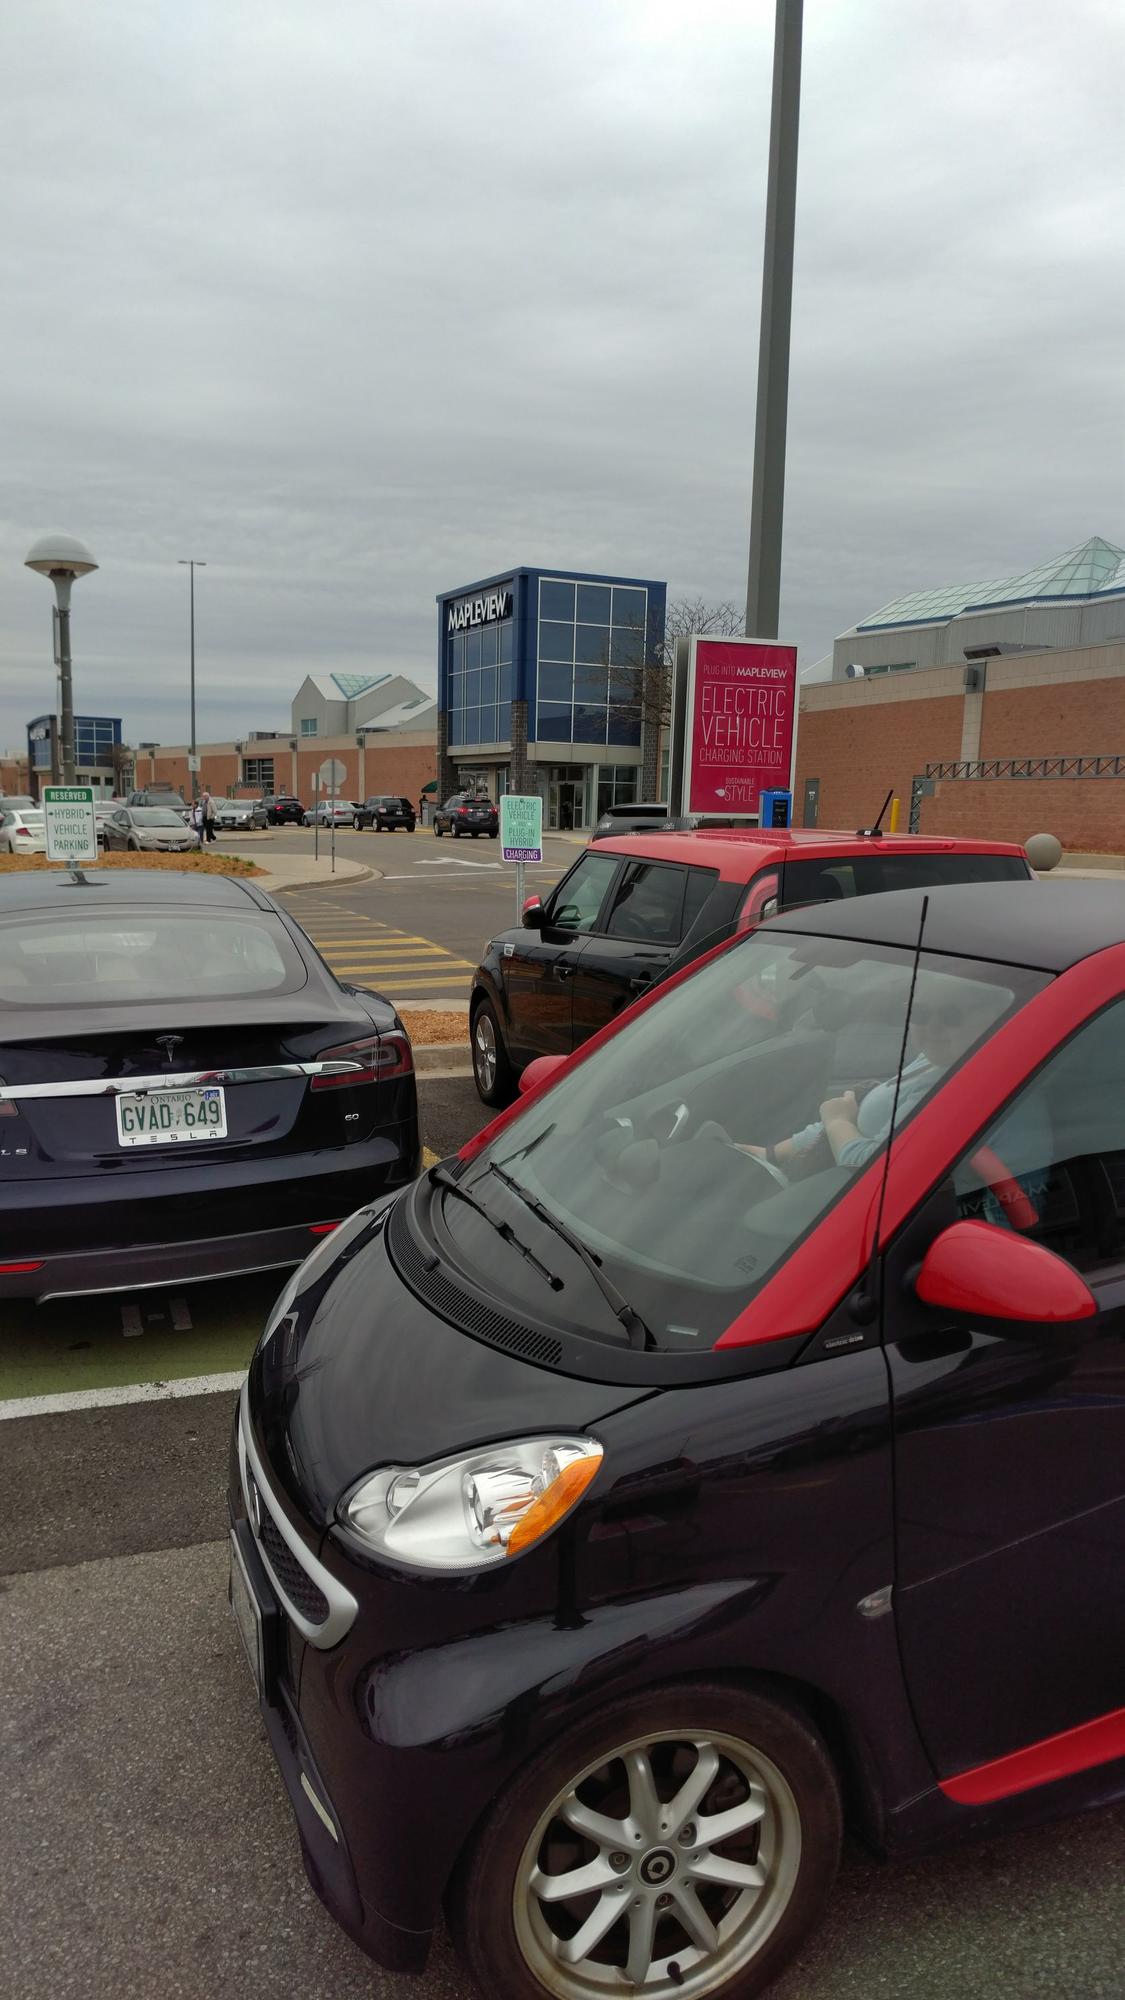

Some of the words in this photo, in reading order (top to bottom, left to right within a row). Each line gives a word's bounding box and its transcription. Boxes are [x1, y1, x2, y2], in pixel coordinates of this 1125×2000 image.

[448, 591, 507, 631] MAPLEVIEW
[704, 664, 719, 675] PLUG
[721, 665, 736, 676] INTO
[736, 667, 787, 679] MAPLEVIEW
[702, 686, 785, 716] ELECTRIC
[701, 715, 784, 748] VEHICLE
[700, 747, 744, 763] CHARGING
[747, 750, 782, 764] STATION
[50, 791, 87, 800] RESERVED
[724, 785, 754, 802] STYLE
[507, 801, 536, 811] ELECTRIC
[55, 808, 85, 819] HYBRID
[508, 811, 534, 820] VEHICLE
[54, 823, 88, 835] VEHICLE
[508, 827, 535, 837] PLUG-IN
[53, 839, 89, 850] PARKING
[510, 838, 534, 847] HYBRID
[506, 849, 538, 859] CHARGING
[150, 1094, 192, 1105] ONTARIO
[123, 1103, 171, 1132] GVAD
[184, 1100, 220, 1126] 649
[344, 1113, 360, 1121] 60
[129, 1130, 217, 1145] TESLA
